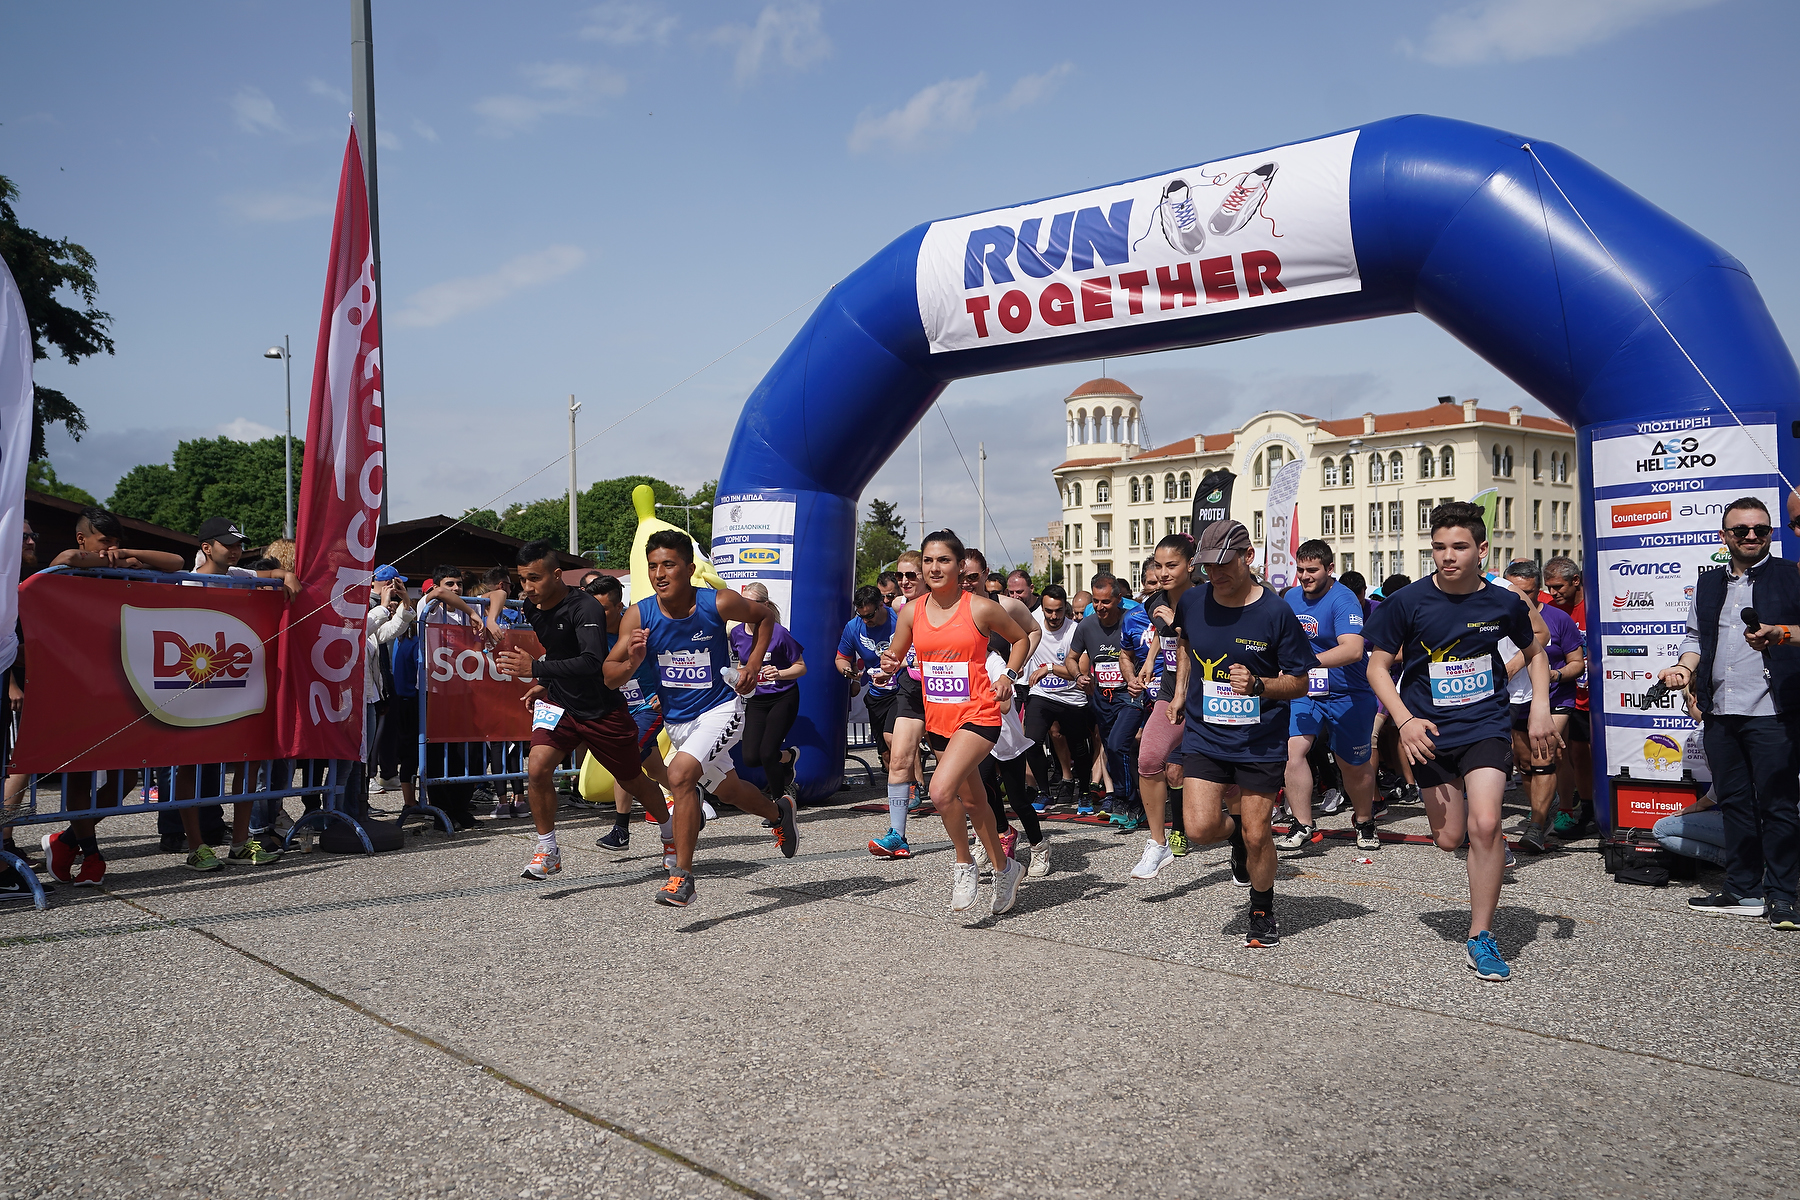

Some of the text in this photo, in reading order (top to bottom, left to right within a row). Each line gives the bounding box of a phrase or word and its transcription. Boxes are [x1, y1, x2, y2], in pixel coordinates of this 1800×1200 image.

[964, 198, 1134, 290] RUN
[966, 249, 1287, 338] TOGETHER
[1637, 416, 1711, 434] ΥΠΟΣΤΗΡΙΞΗ
[1636, 453, 1717, 473] HELEXPO
[1651, 479, 1704, 493] ΧΟΡΗΓΟΙ
[1613, 510, 1669, 523] Counterpain
[1271, 515, 1287, 565] 94.5
[1619, 562, 1681, 576] avance
[1626, 599, 1654, 607] ΑΛΦΑ
[1621, 624, 1666, 634] ΧΟΡΗΓΟΙ
[1099, 644, 1116, 652] Body
[152, 630, 253, 683] Dole
[665, 667, 707, 679] 6706
[1445, 664, 1463, 672] RUN
[1041, 678, 1065, 686] 6702
[1099, 671, 1124, 681] 6092
[927, 678, 964, 692] 6830
[1309, 678, 1325, 689] 18
[1437, 673, 1488, 694] 6080
[1208, 698, 1255, 713] 6080
